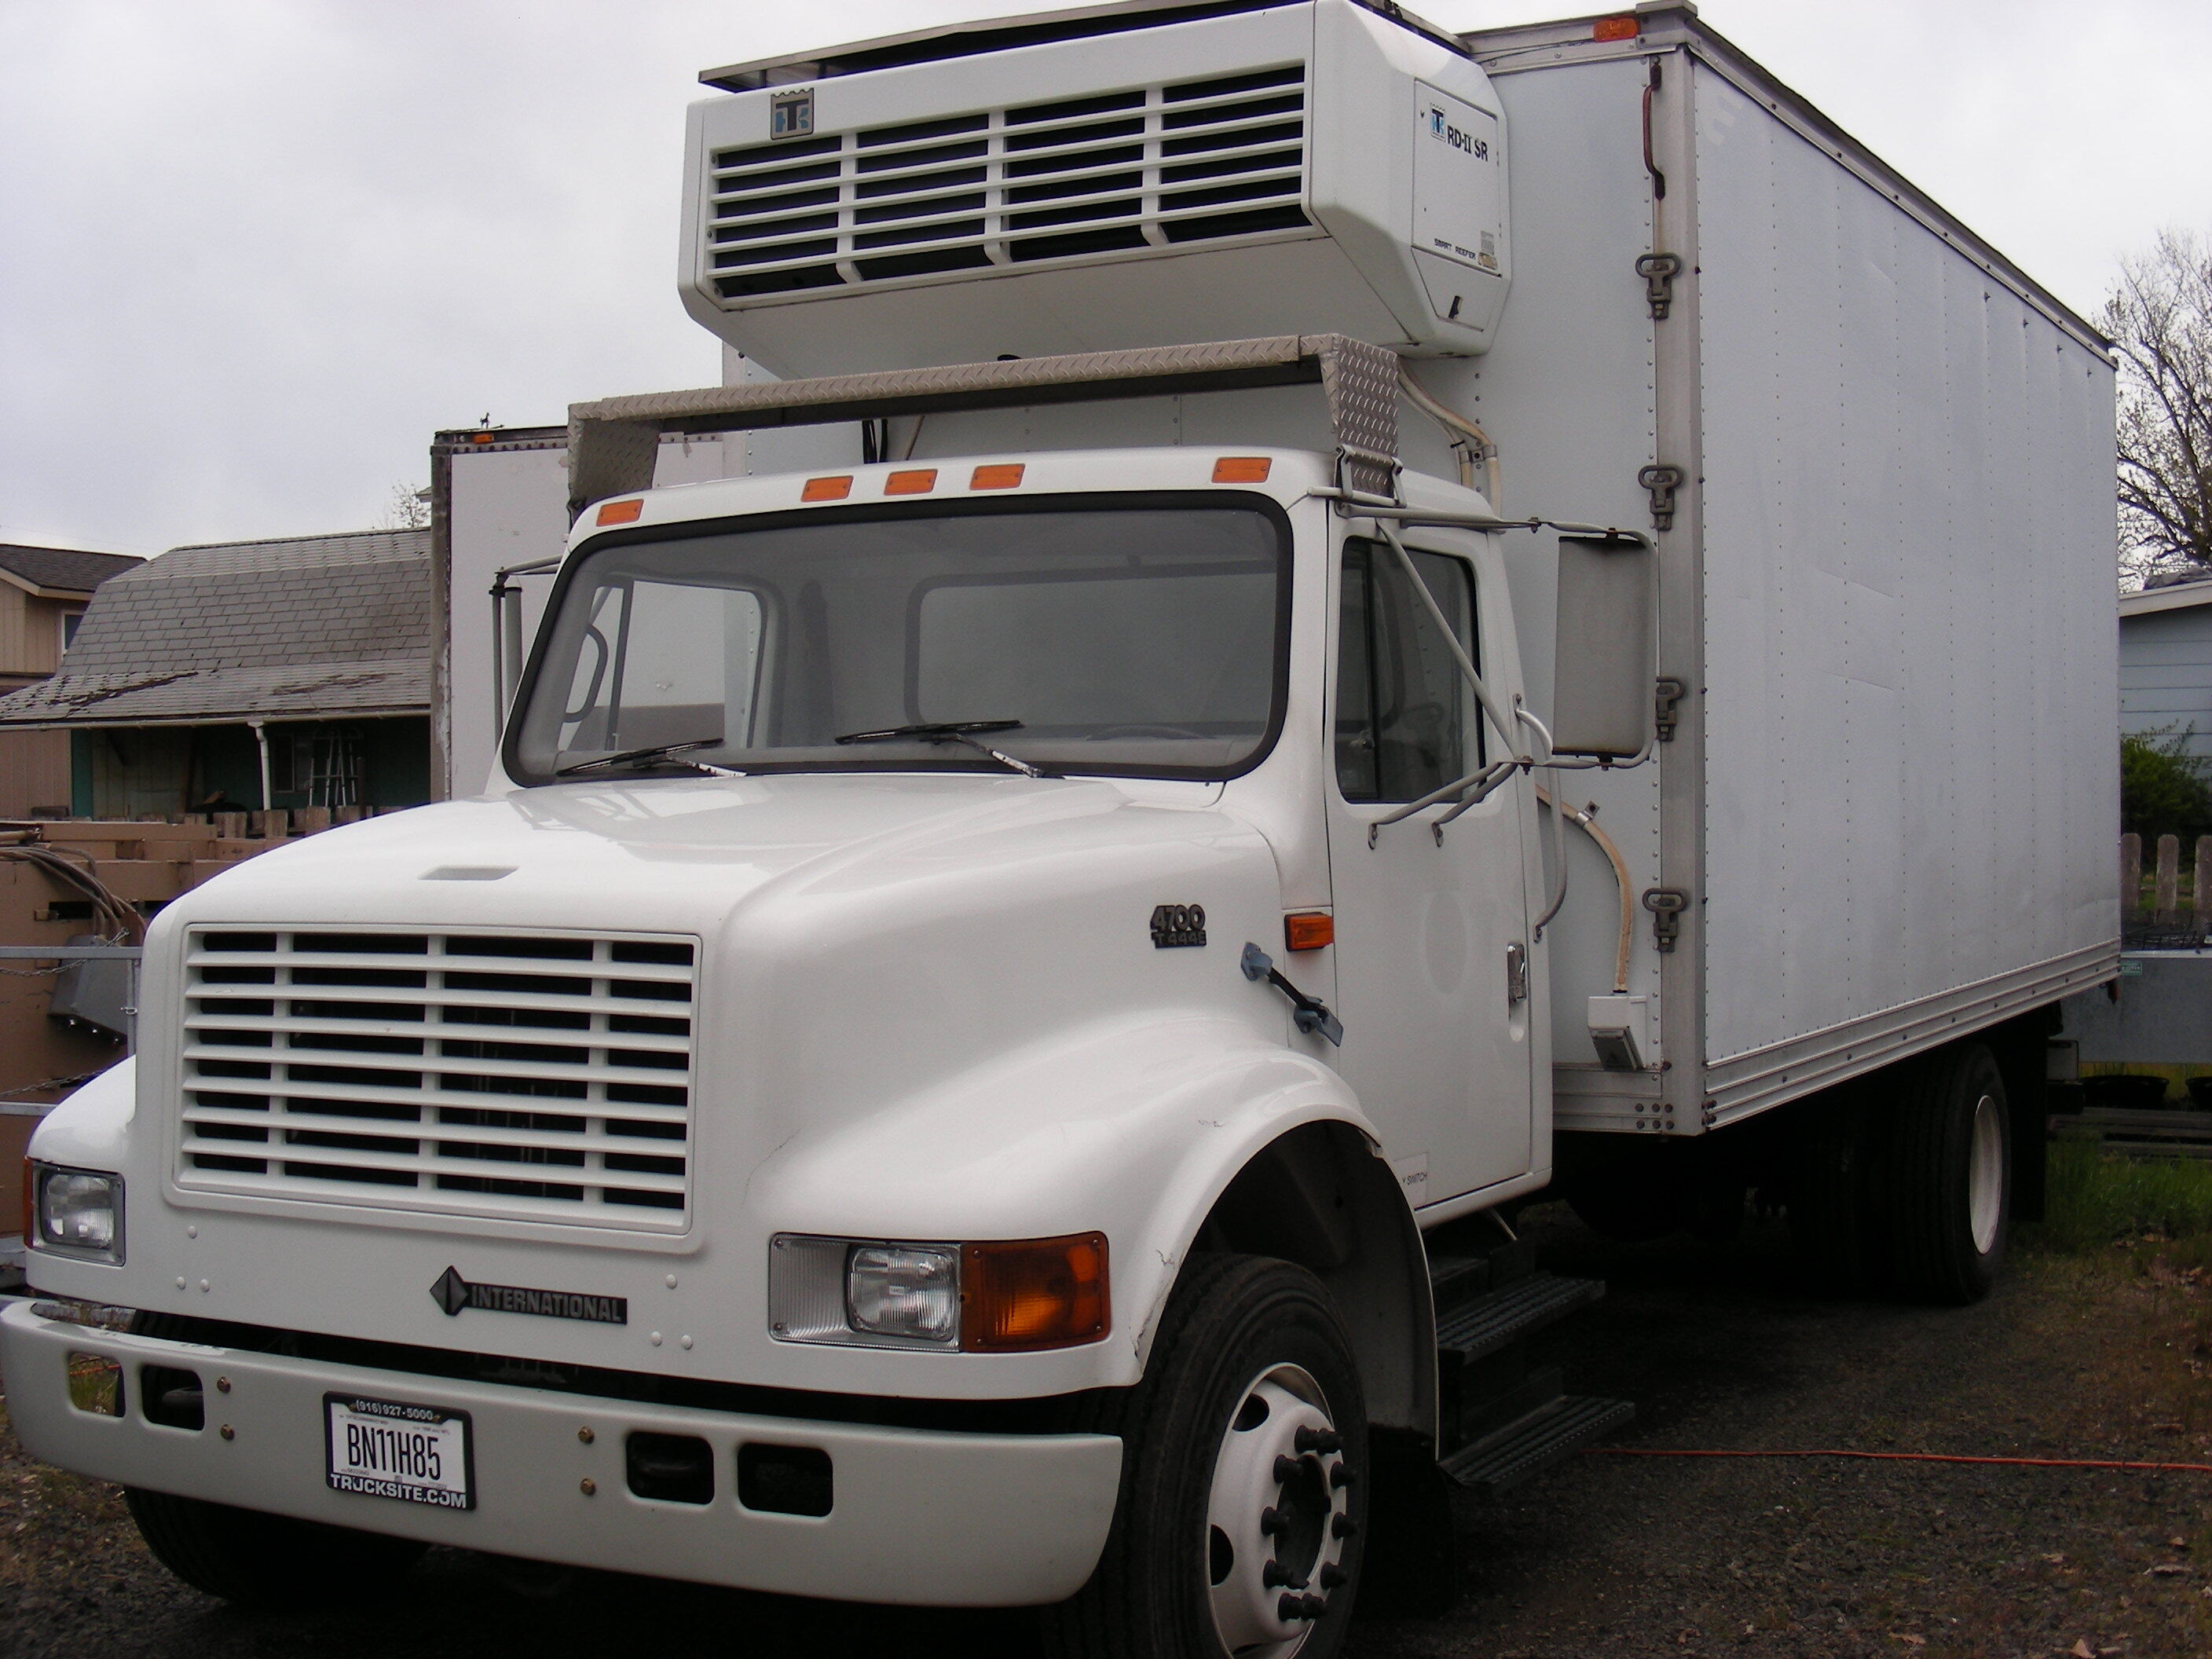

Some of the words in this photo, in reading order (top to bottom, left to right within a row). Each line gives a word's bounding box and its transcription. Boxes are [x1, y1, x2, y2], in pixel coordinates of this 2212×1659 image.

[1474, 138, 1489, 162] SR
[1434, 238, 1452, 251] SMART
[1455, 246, 1476, 261] REEFER
[1150, 904, 1205, 932] 4700
[1407, 1171, 1427, 1185] SWITCH
[471, 1284, 622, 1323] INTERNATIONAL
[347, 1423, 441, 1481] BN11H85
[331, 1473, 467, 1509] TRUCKSITE.COM
